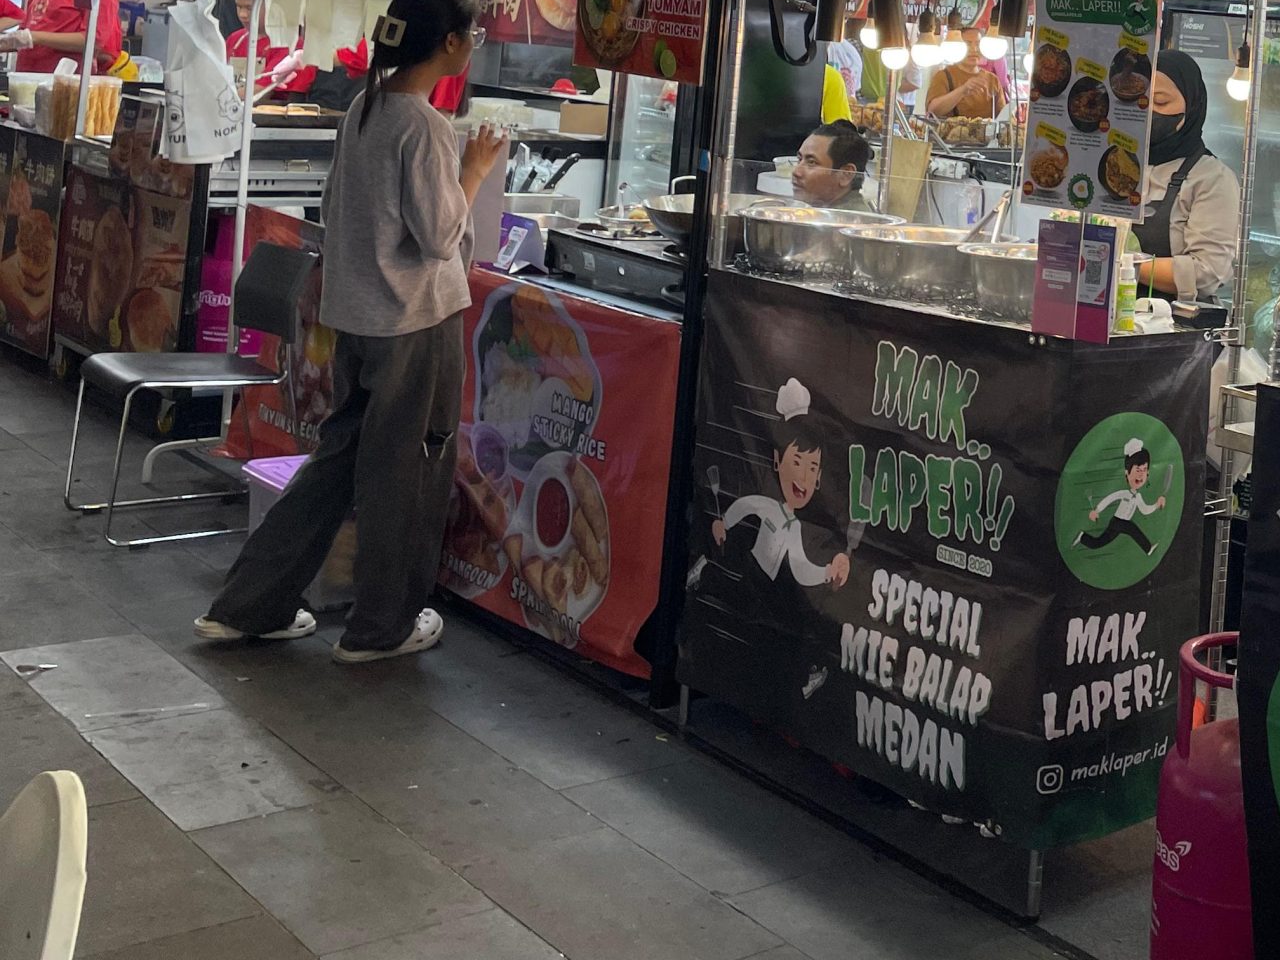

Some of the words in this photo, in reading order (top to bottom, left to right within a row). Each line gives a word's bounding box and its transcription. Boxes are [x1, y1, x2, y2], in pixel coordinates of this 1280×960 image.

[625, 15, 658, 33] CRISPY
[657, 20, 701, 40] CHICKEN
[1082, 0, 1121, 13] LAPER!!
[550, 391, 594, 426] MANGO
[871, 340, 992, 461] MAK..
[532, 414, 574, 447] STICKY
[576, 432, 606, 462] RICE
[848, 444, 1015, 552] LAPER!!
[936, 544, 967, 571] SINCE
[968, 553, 994, 578] 2020
[867, 568, 984, 660] SPECIAL
[1065, 610, 1156, 667] MAK..
[840, 623, 899, 690] MIE
[903, 647, 994, 728] BALAP
[1043, 663, 1173, 741] LAPER!!
[854, 691, 967, 792] MEDAN
[1071, 737, 1169, 784] maklaper.id
